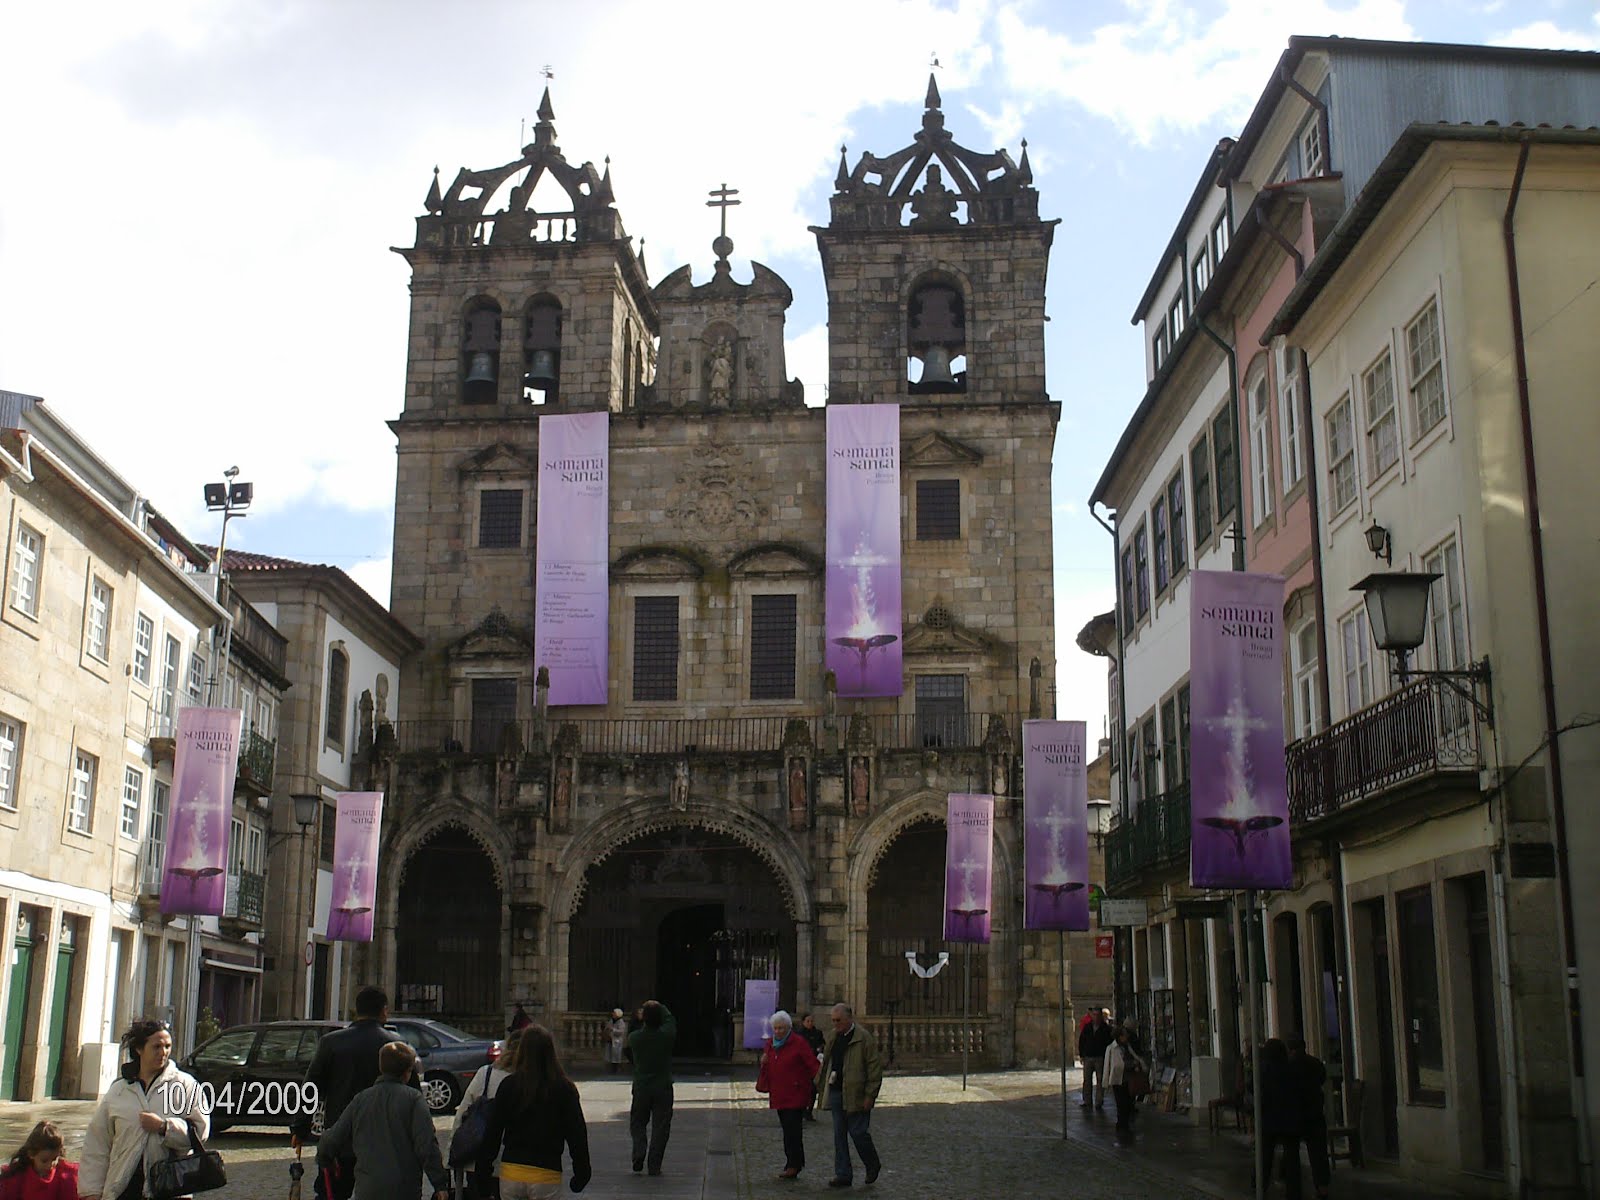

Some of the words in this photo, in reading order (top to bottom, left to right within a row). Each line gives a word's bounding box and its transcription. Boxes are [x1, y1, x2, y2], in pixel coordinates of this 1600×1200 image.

[832, 446, 894, 458] semana
[545, 458, 603, 470] semana
[850, 459, 894, 470] santa
[561, 470, 603, 482] santa
[1201, 607, 1274, 624] semana
[1221, 624, 1273, 640] santa
[184, 731, 233, 741] semana
[196, 742, 232, 752] santa
[1031, 744, 1080, 753] semana
[1044, 755, 1080, 764] santa
